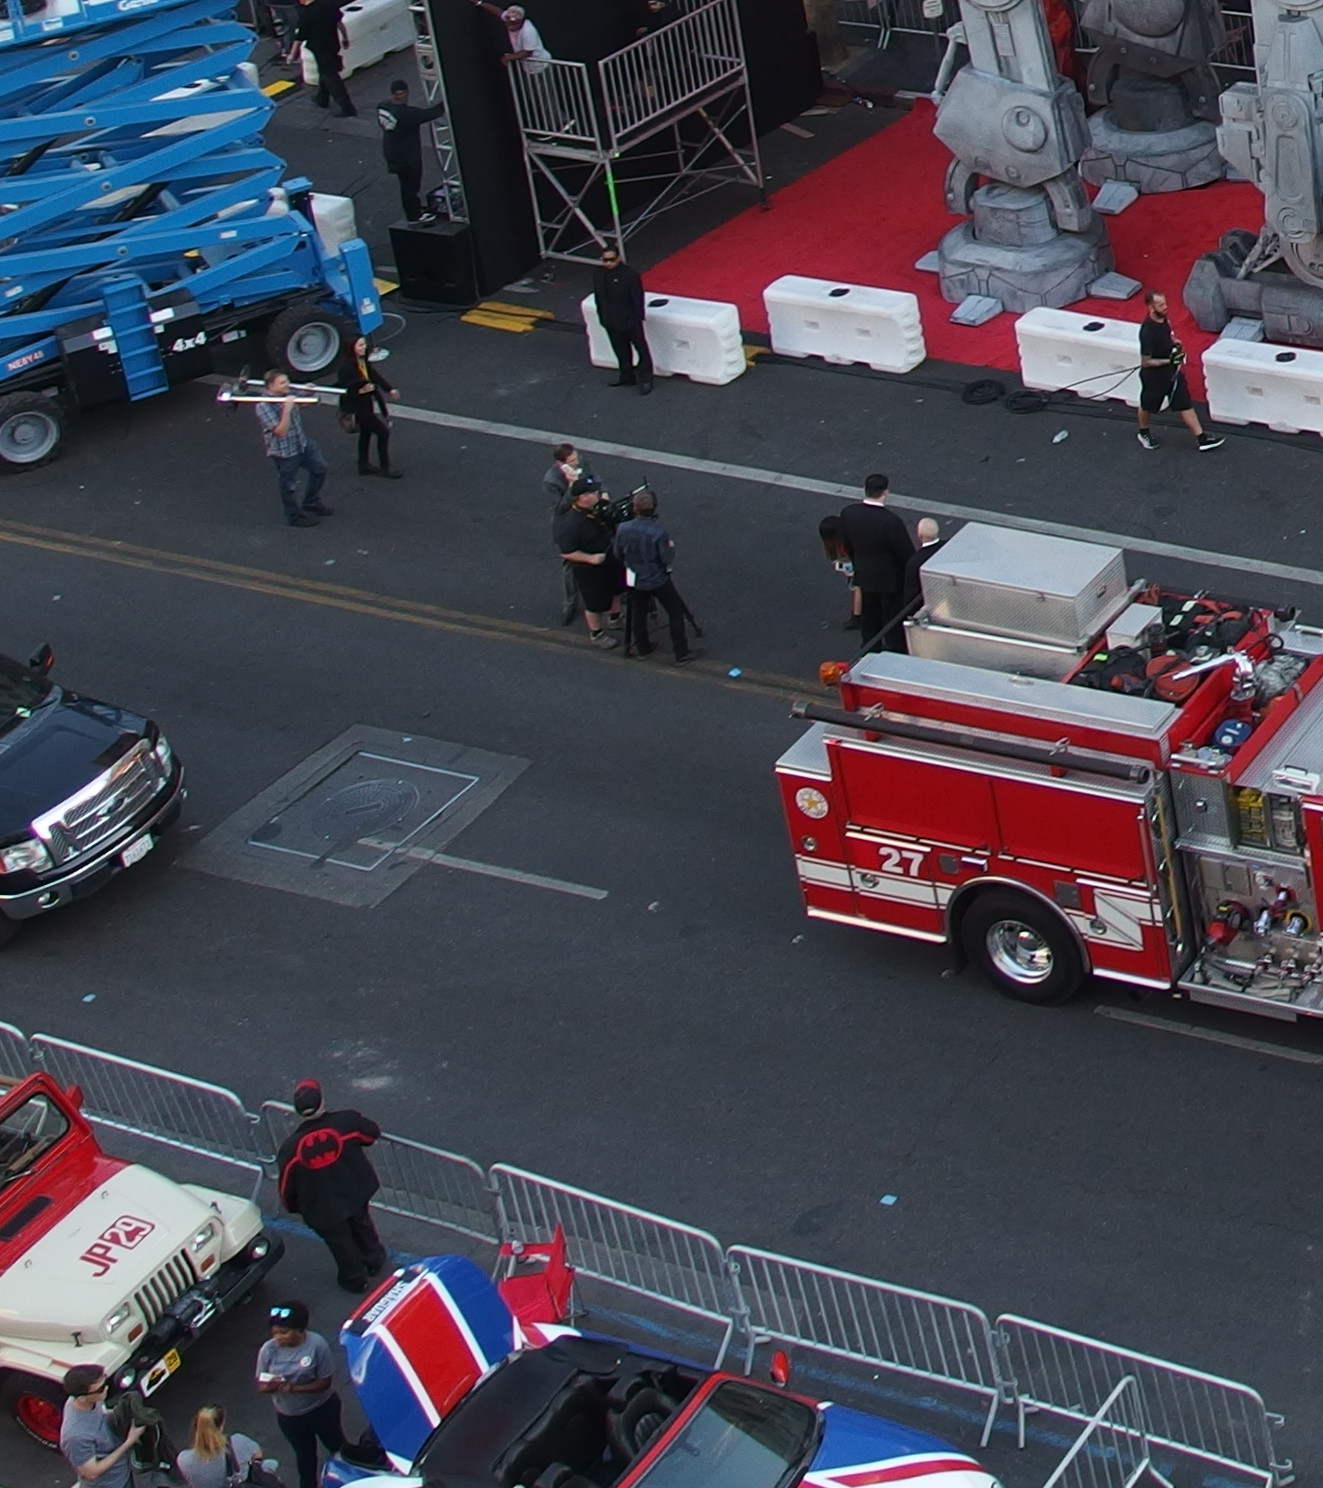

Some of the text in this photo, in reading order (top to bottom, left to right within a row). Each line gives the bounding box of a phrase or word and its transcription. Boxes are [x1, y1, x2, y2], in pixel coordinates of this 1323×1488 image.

[172, 331, 208, 353] 4x4
[877, 846, 925, 878] 27
[79, 1215, 153, 1278] JP 29
